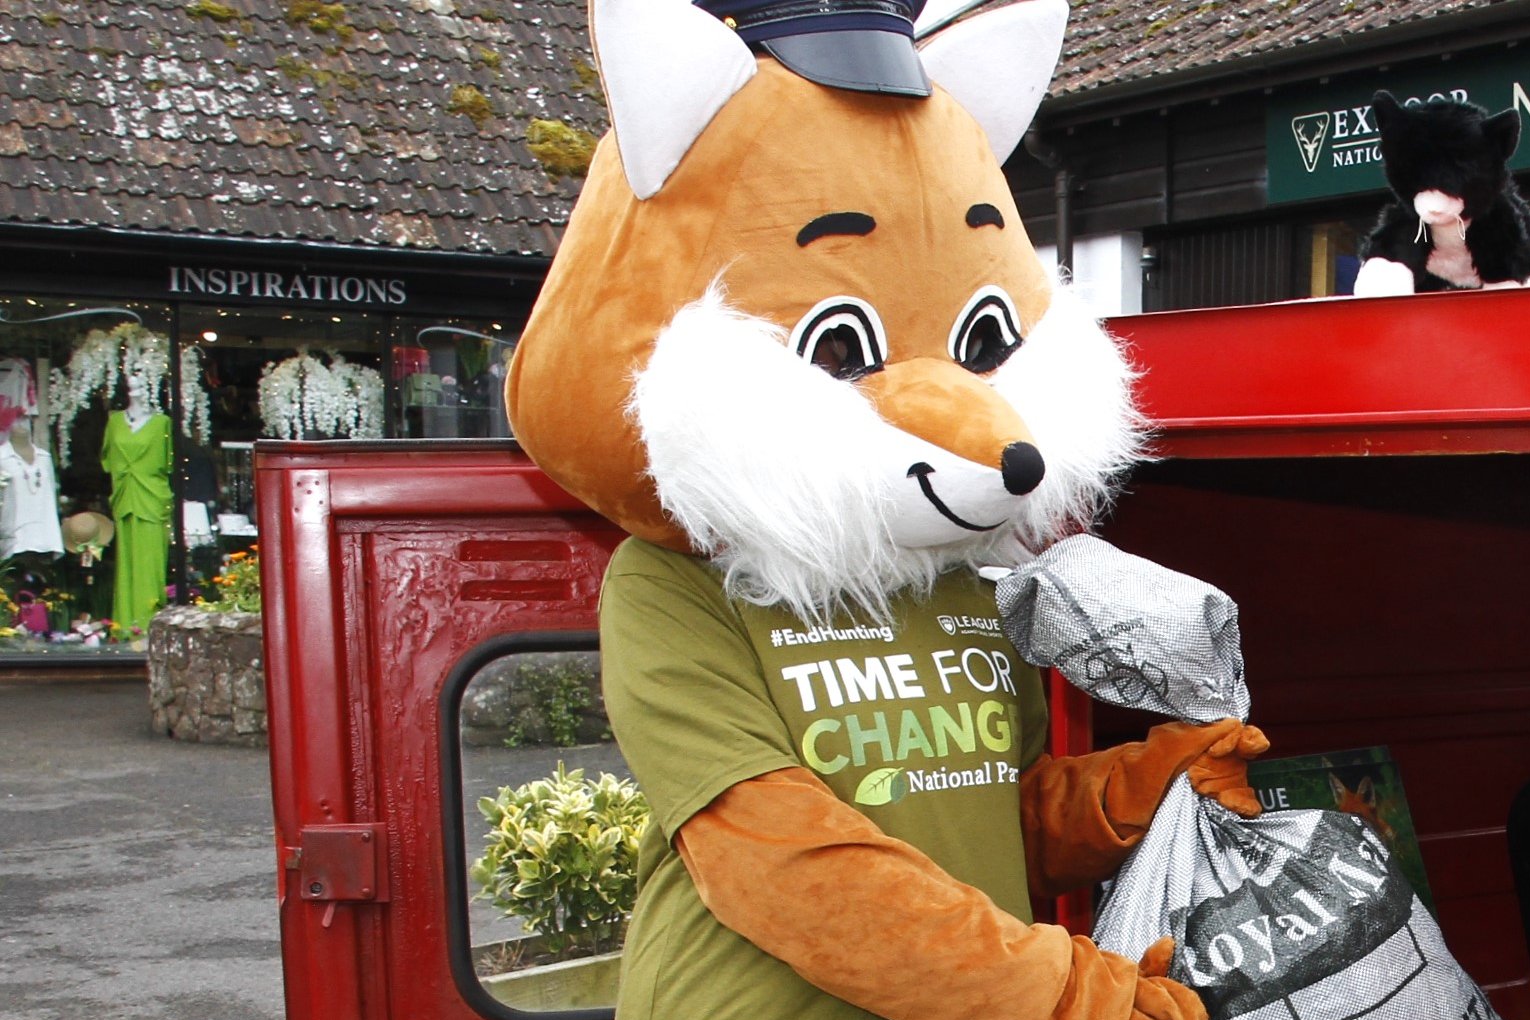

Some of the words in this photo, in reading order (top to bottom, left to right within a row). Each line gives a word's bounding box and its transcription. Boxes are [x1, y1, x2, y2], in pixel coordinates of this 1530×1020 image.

[169, 266, 406, 305] INSPIRATIONS
[770, 625, 894, 647] #EndHunting
[954, 615, 1001, 631] LEAGUE
[781, 653, 926, 712] TIME
[931, 647, 1017, 696] FOR
[906, 761, 992, 793] National
